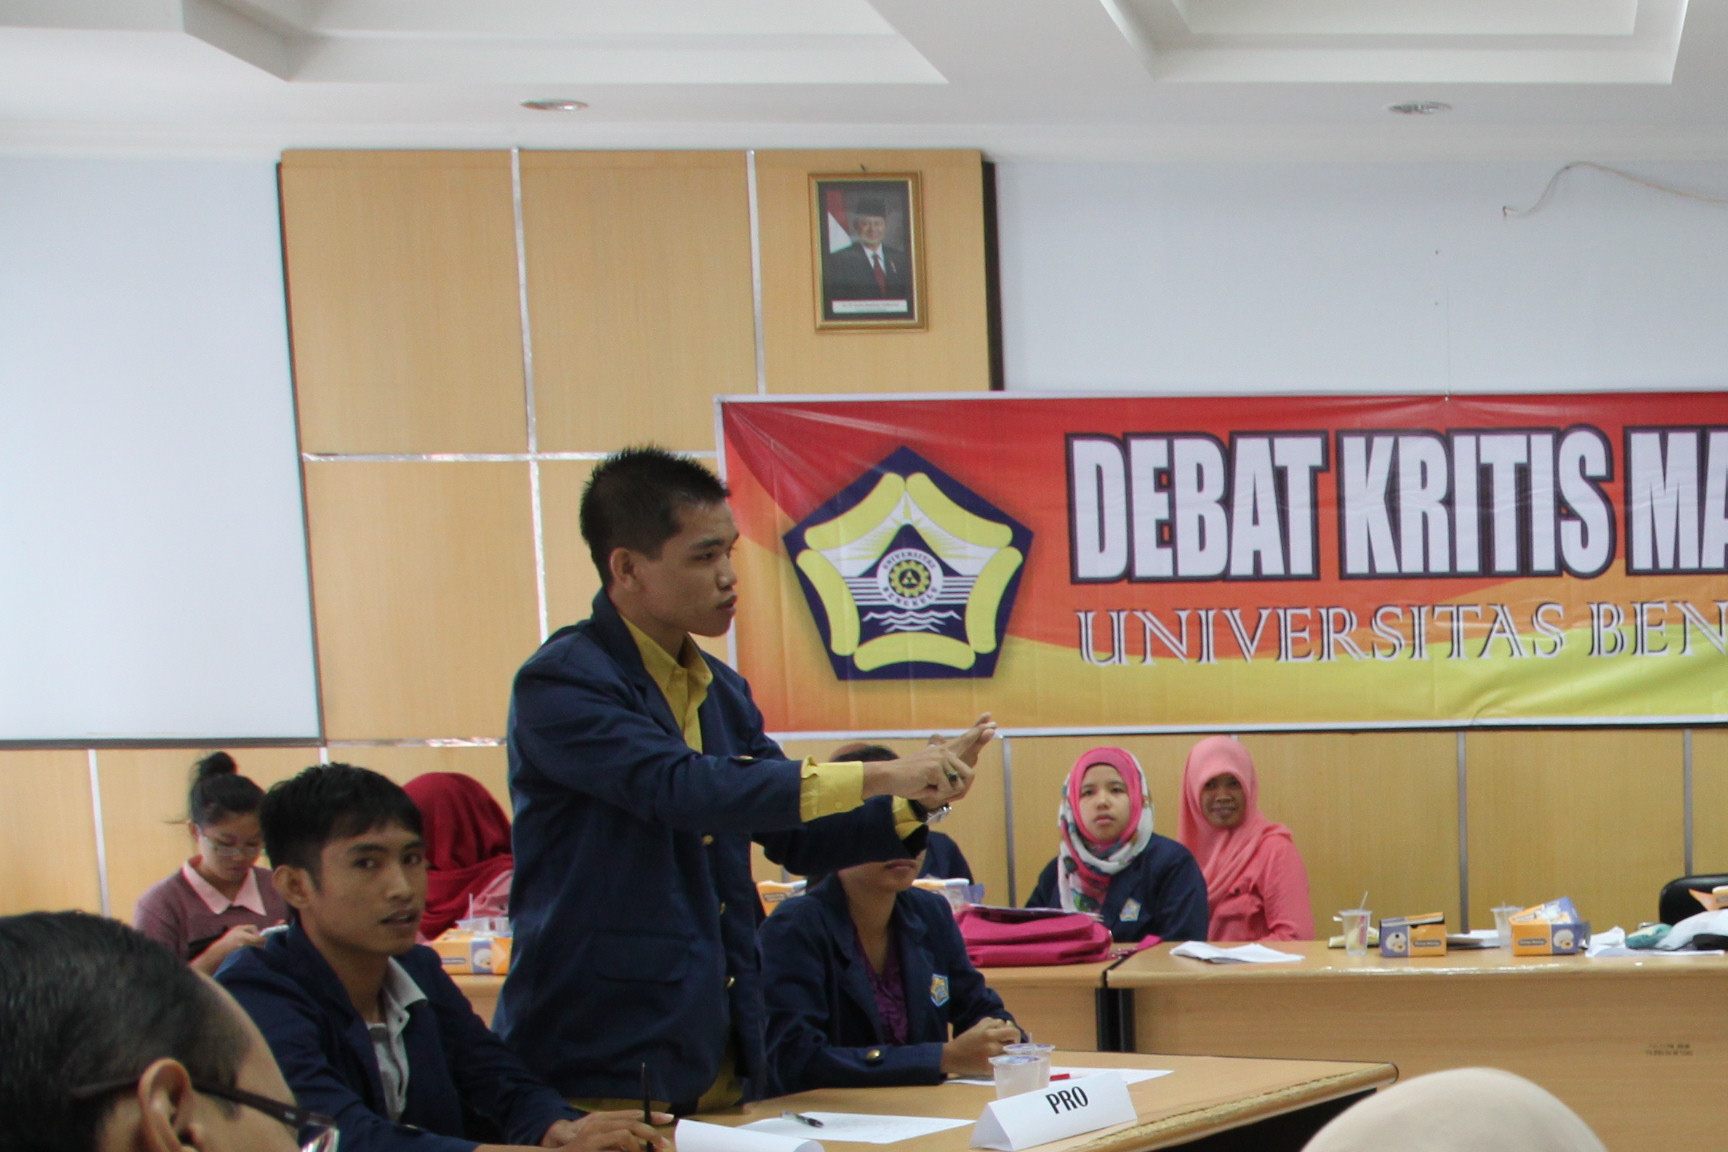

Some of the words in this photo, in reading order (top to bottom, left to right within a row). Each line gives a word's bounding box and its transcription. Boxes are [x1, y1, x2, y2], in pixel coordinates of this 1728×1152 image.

[1065, 430, 1330, 584] DEBAT
[1336, 423, 1617, 580] KRITIS
[1075, 601, 1566, 666] UNIVERSITAS
[1045, 1085, 1089, 1115] PRO
